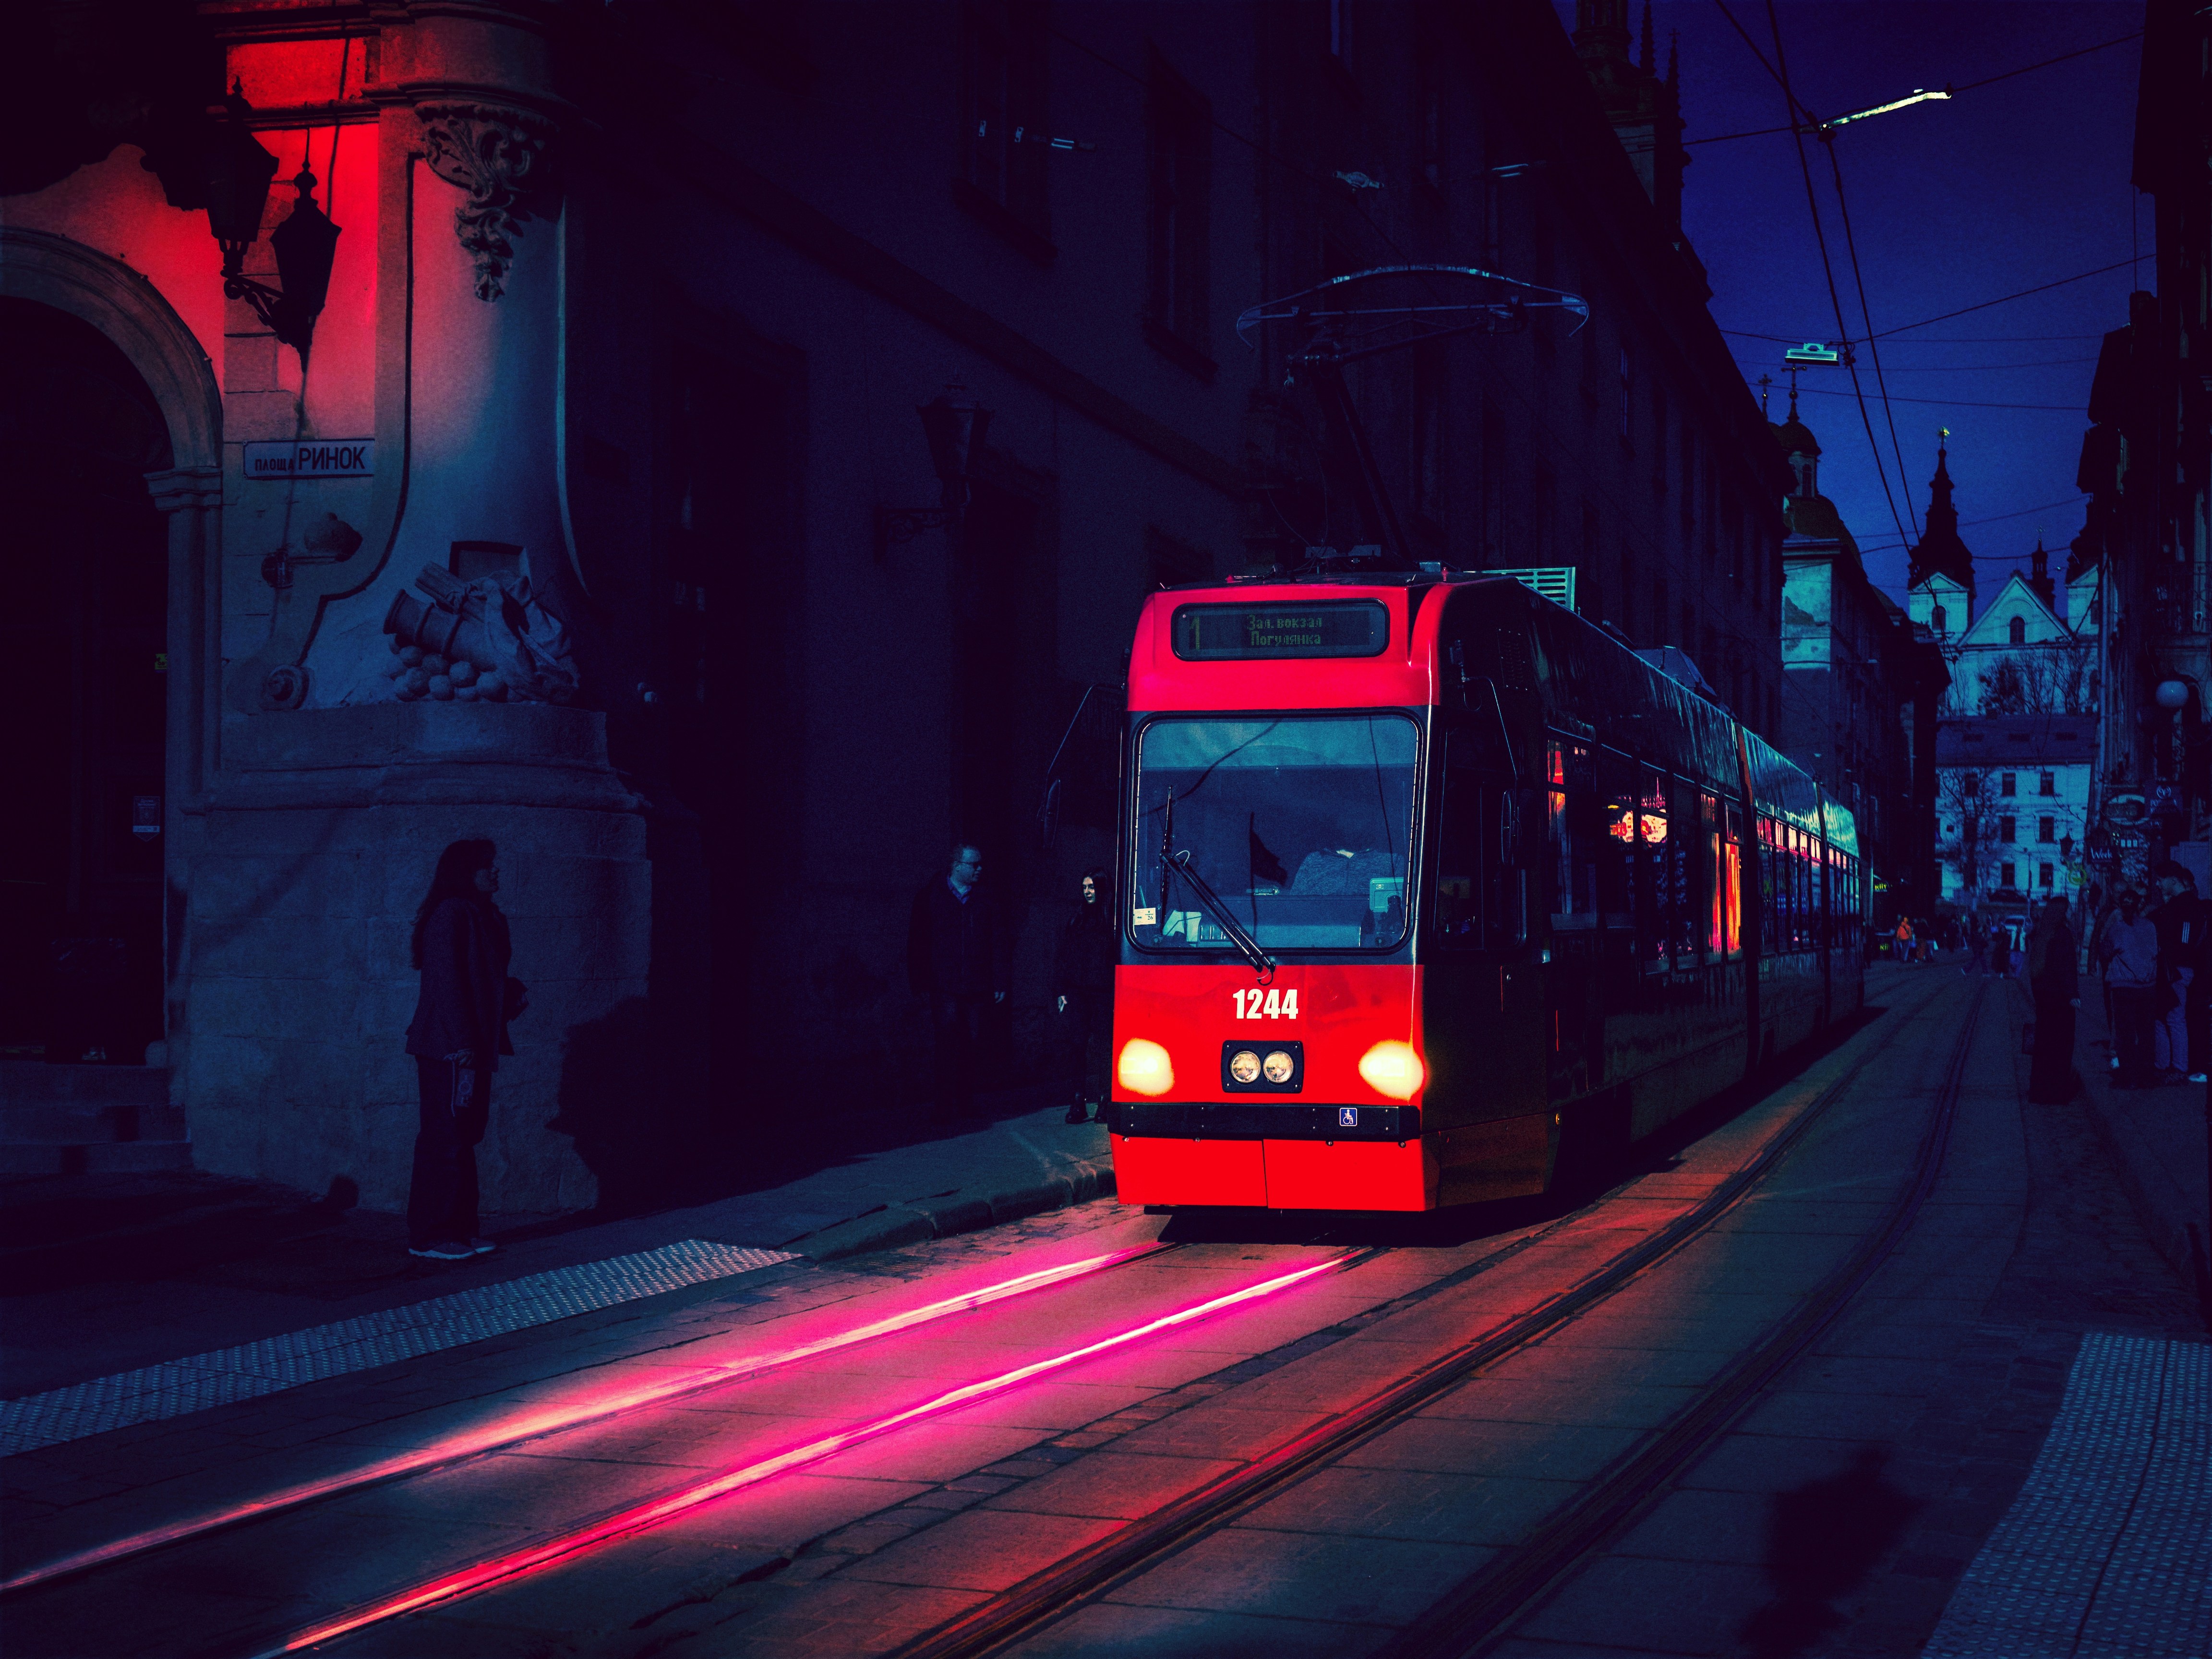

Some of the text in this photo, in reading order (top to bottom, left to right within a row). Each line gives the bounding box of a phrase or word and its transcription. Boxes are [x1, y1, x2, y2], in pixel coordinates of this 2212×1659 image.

[299, 446, 365, 470] РИНОК
[1277, 617, 1322, 628] вокзал
[1190, 616, 1200, 649] 1
[1251, 631, 1321, 646] Погулянка
[2091, 846, 2113, 859] Week
[1232, 988, 1299, 1019] 1244
